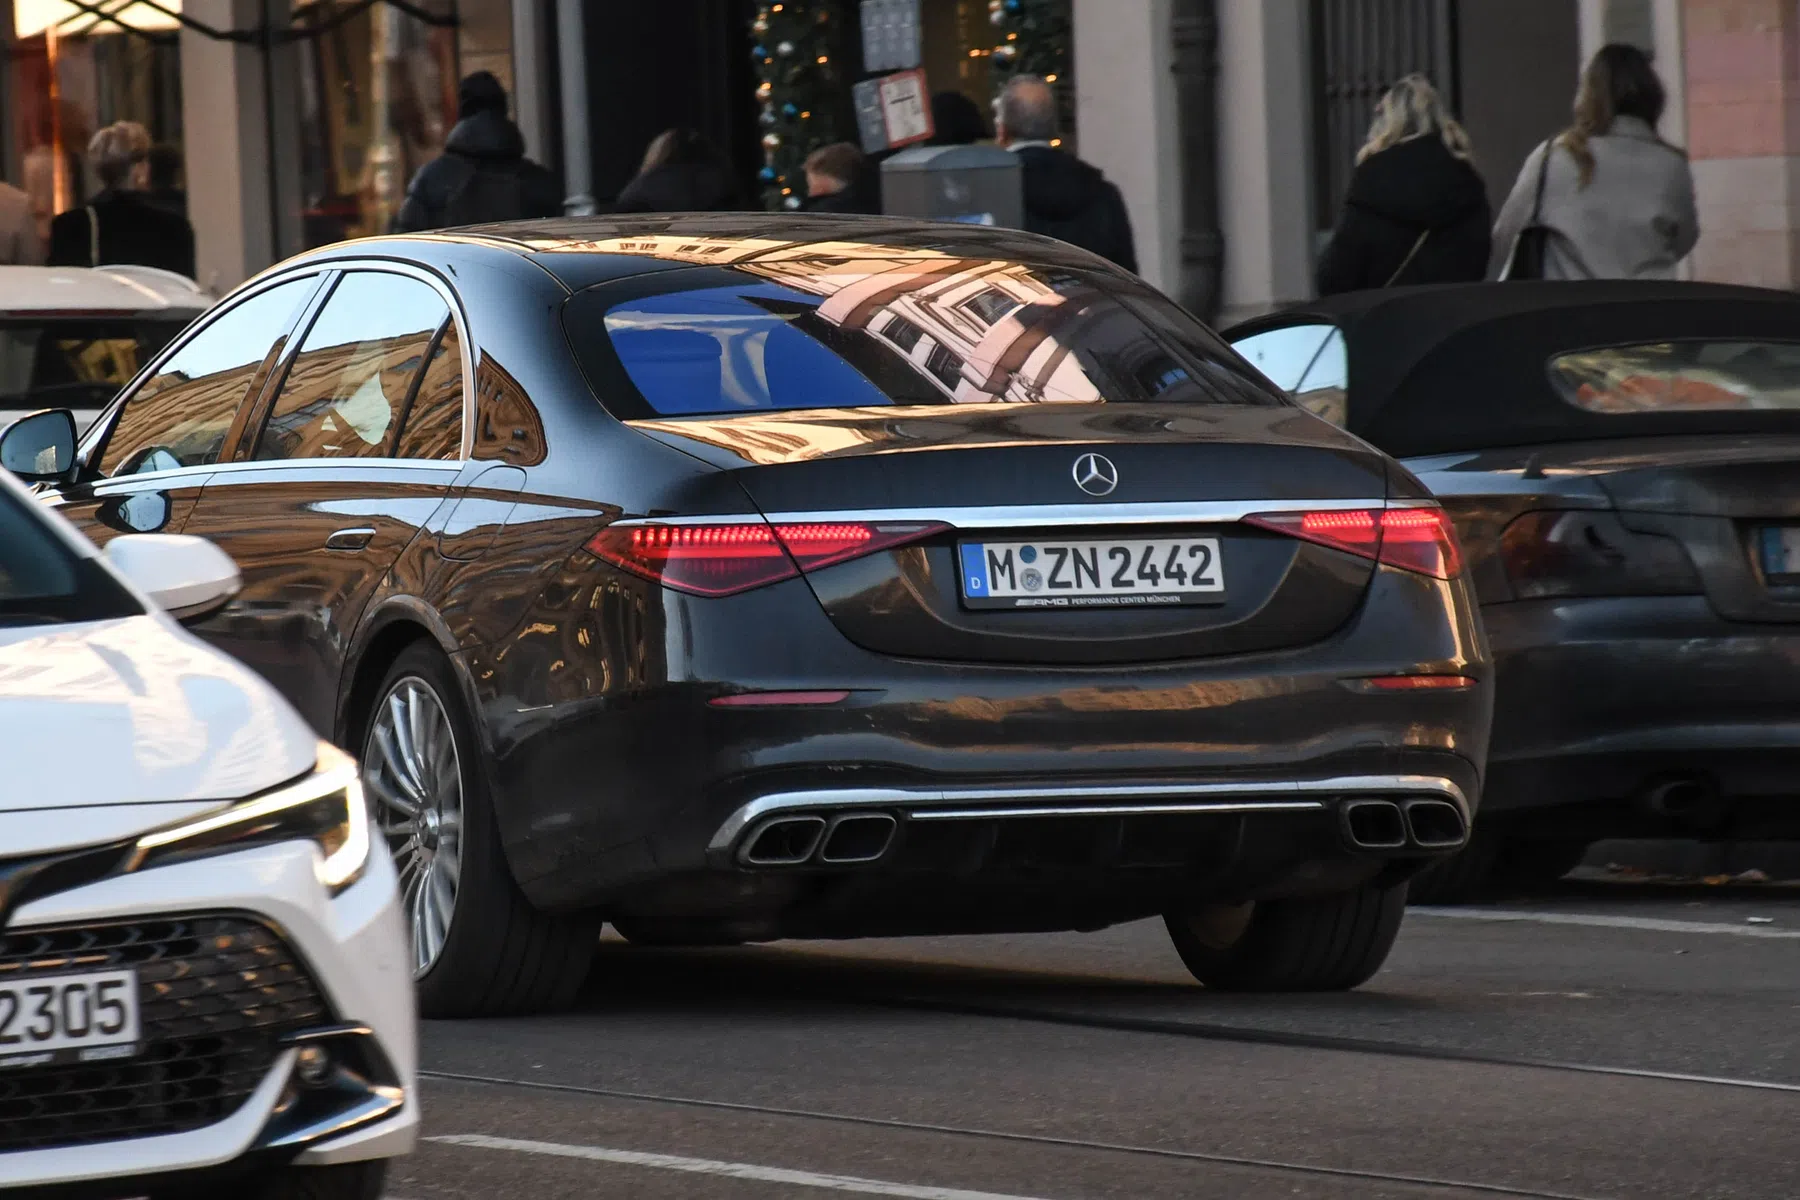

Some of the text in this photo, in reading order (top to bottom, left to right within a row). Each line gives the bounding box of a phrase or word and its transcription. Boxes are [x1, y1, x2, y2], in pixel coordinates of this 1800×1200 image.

[987, 544, 1215, 591] M ZN 2442
[971, 577, 981, 590] D
[1034, 594, 1181, 606] AMG PERFORMANCE CENTER MÜNCHEN
[0, 979, 126, 1044] 2305
